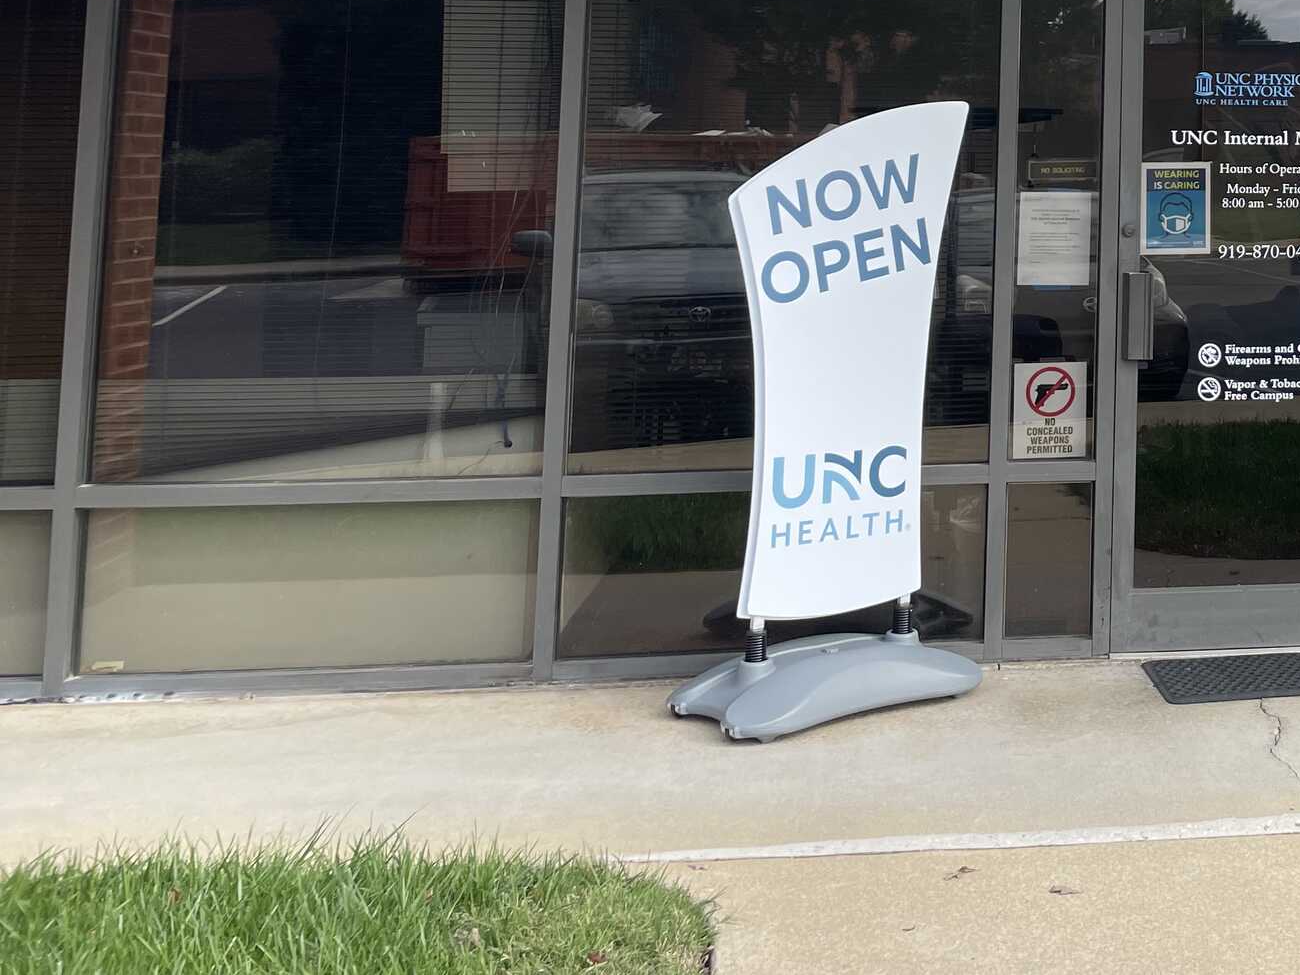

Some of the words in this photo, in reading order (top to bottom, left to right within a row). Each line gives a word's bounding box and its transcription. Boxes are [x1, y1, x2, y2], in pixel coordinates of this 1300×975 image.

[1215, 73, 1251, 86] UNC
[1214, 85, 1295, 98] NETWORK
[1195, 98, 1217, 106] UNC
[1220, 98, 1259, 106] HEALTH
[1262, 99, 1289, 107] CARE
[1171, 130, 1218, 145] UNC
[1223, 130, 1289, 146] Internal
[1154, 170, 1200, 178] WEARING
[1219, 163, 1253, 174] Hours
[1255, 162, 1270, 174] of
[1153, 181, 1163, 190] IS
[1163, 181, 1200, 190] CARING
[1226, 183, 1271, 197] Monday
[766, 153, 920, 236] NOW
[1221, 197, 1246, 209] 8:00
[1248, 200, 1265, 209] am
[1276, 198, 1300, 209] 5:00
[761, 217, 932, 304] OPEN
[1224, 343, 1272, 354] Firearms
[1274, 343, 1294, 354] and
[1224, 355, 1271, 367] Weapons
[1224, 379, 1257, 391] Vapor
[1259, 379, 1269, 389] &
[1224, 391, 1248, 401] Free
[1250, 390, 1294, 402] Campus
[1044, 417, 1056, 426] NO
[1026, 426, 1074, 436] CONCEALED
[1030, 435, 1070, 445] WEAPONS
[1026, 445, 1073, 454] PERMITTED
[772, 445, 908, 510] UNC
[770, 509, 904, 549] HEALTH
